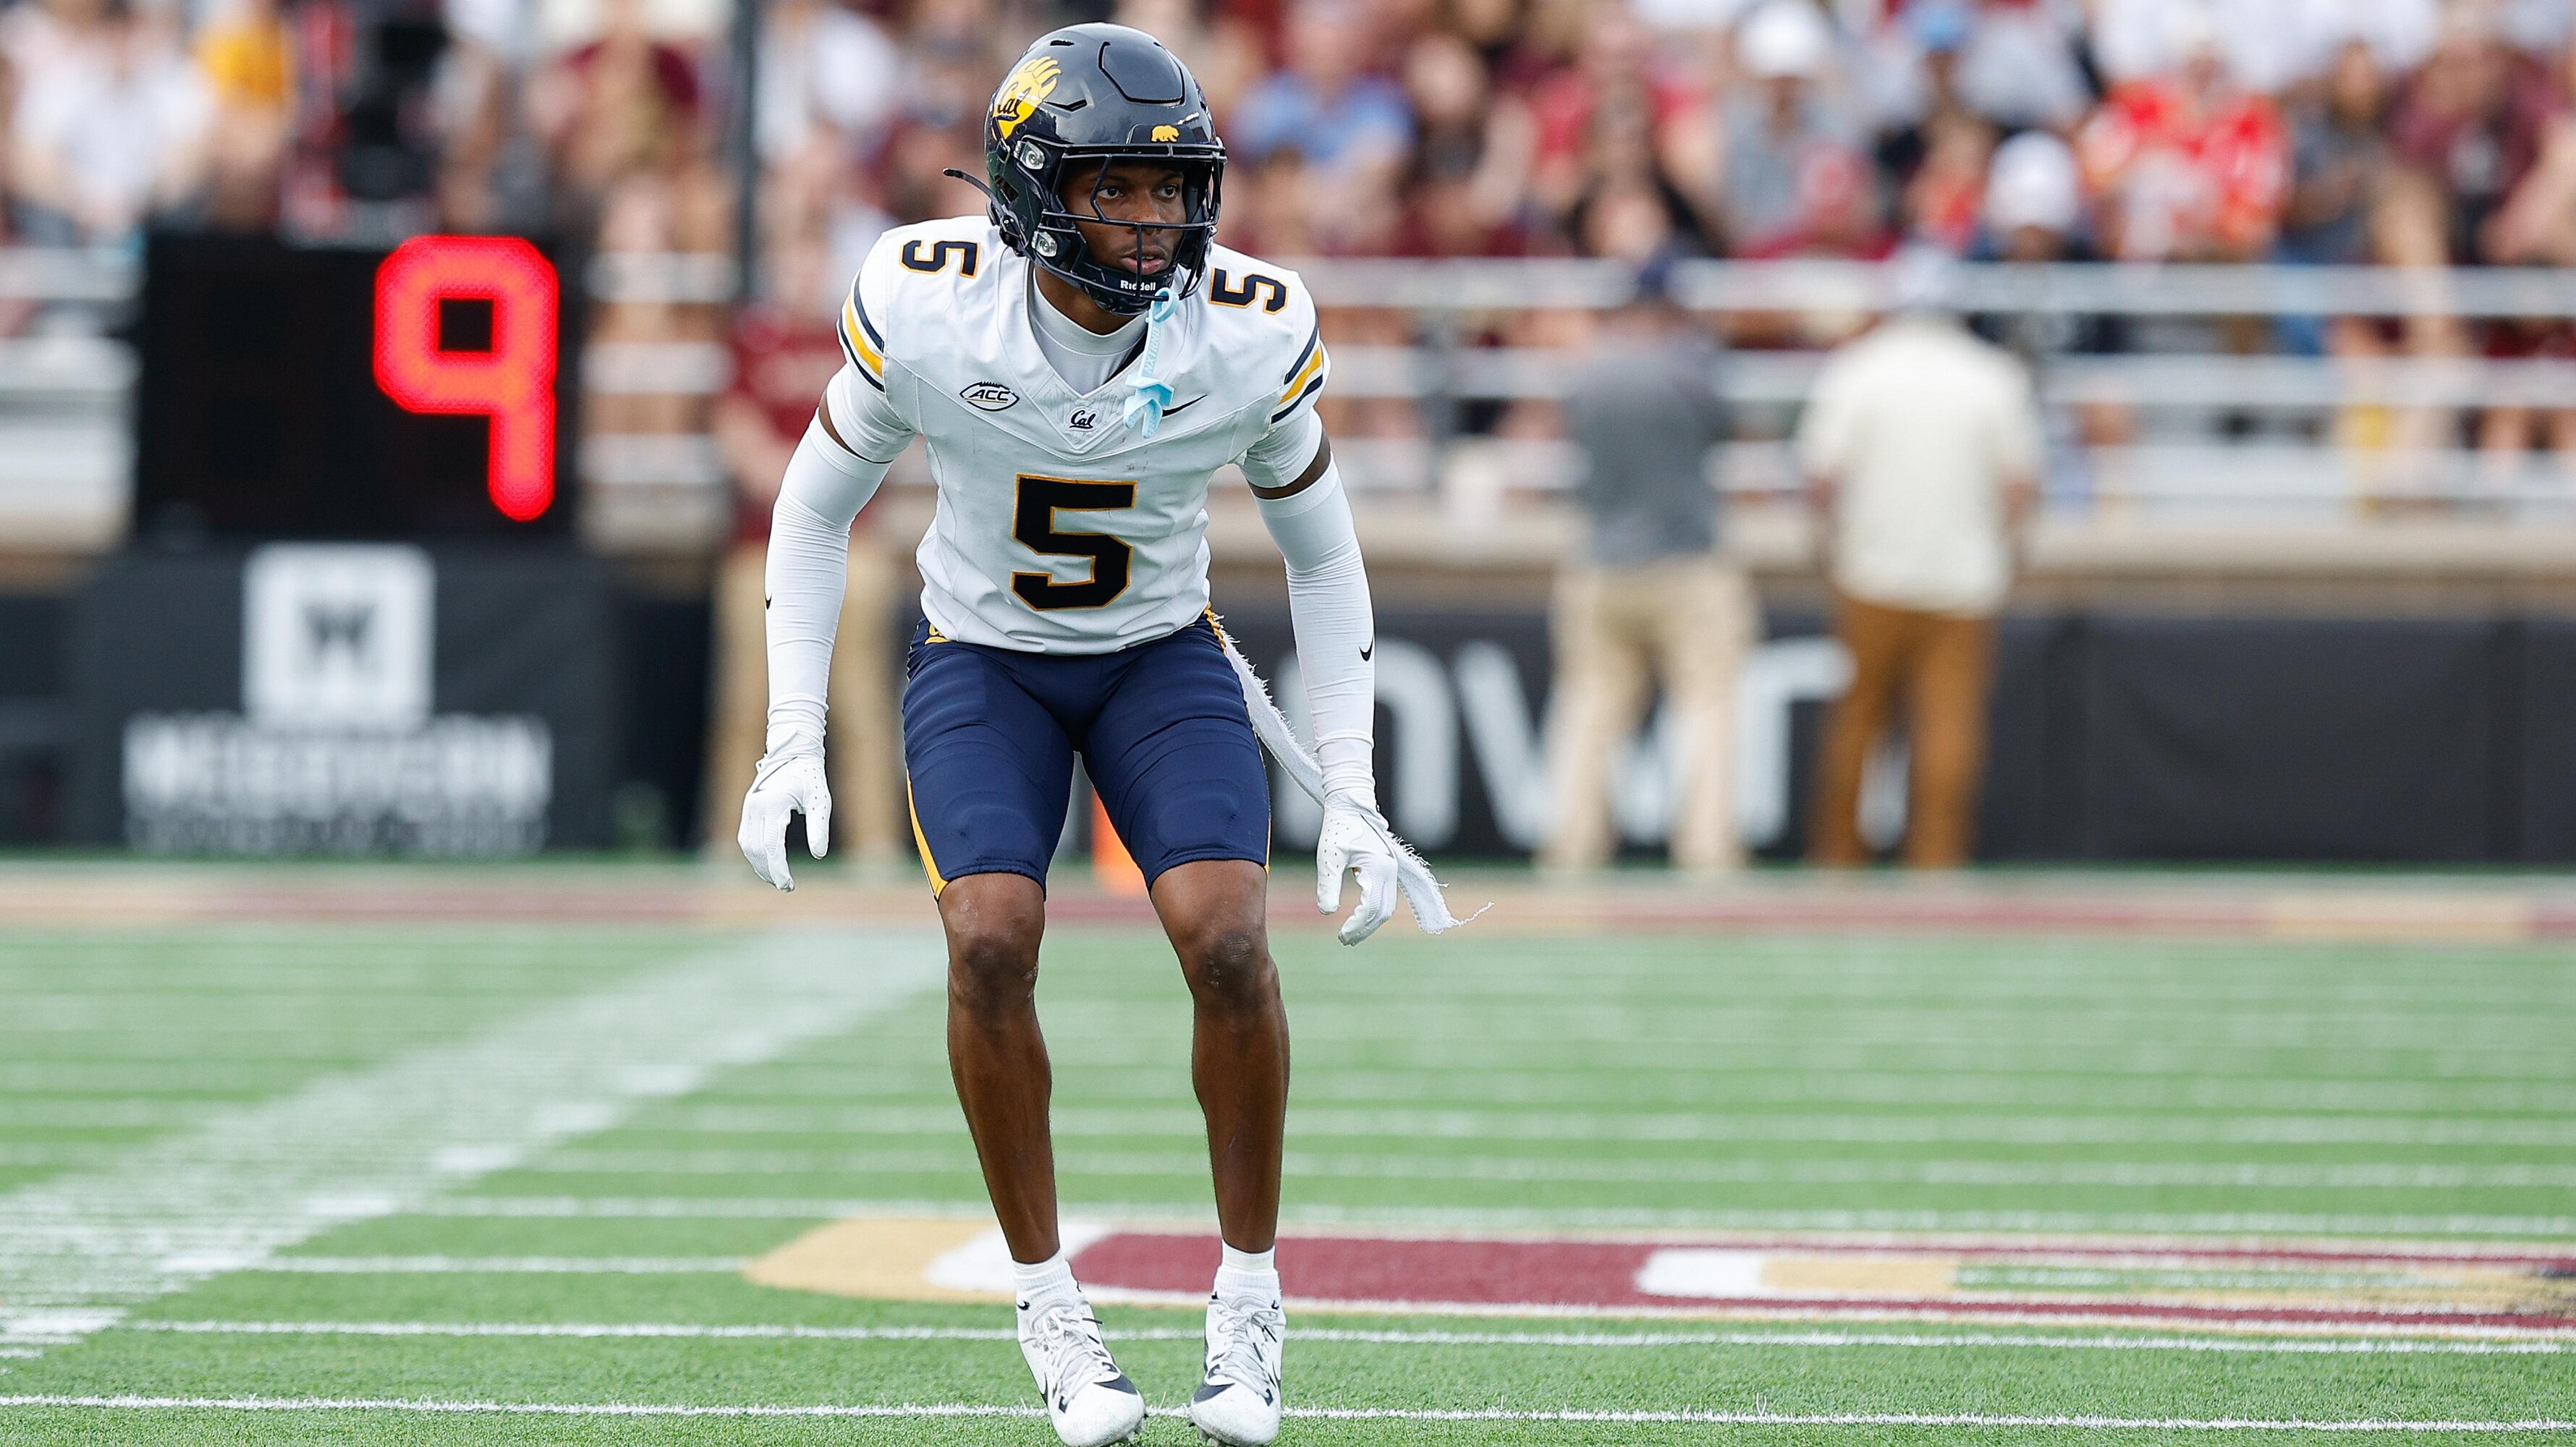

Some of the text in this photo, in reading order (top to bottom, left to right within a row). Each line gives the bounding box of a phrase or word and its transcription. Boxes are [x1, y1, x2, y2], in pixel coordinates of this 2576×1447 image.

[898, 239, 980, 279] 5
[1208, 266, 1289, 315] 5
[373, 234, 559, 522] 9
[969, 389, 1010, 401] ACC
[1069, 409, 1096, 429] Cal
[1011, 473, 1137, 611] 5
